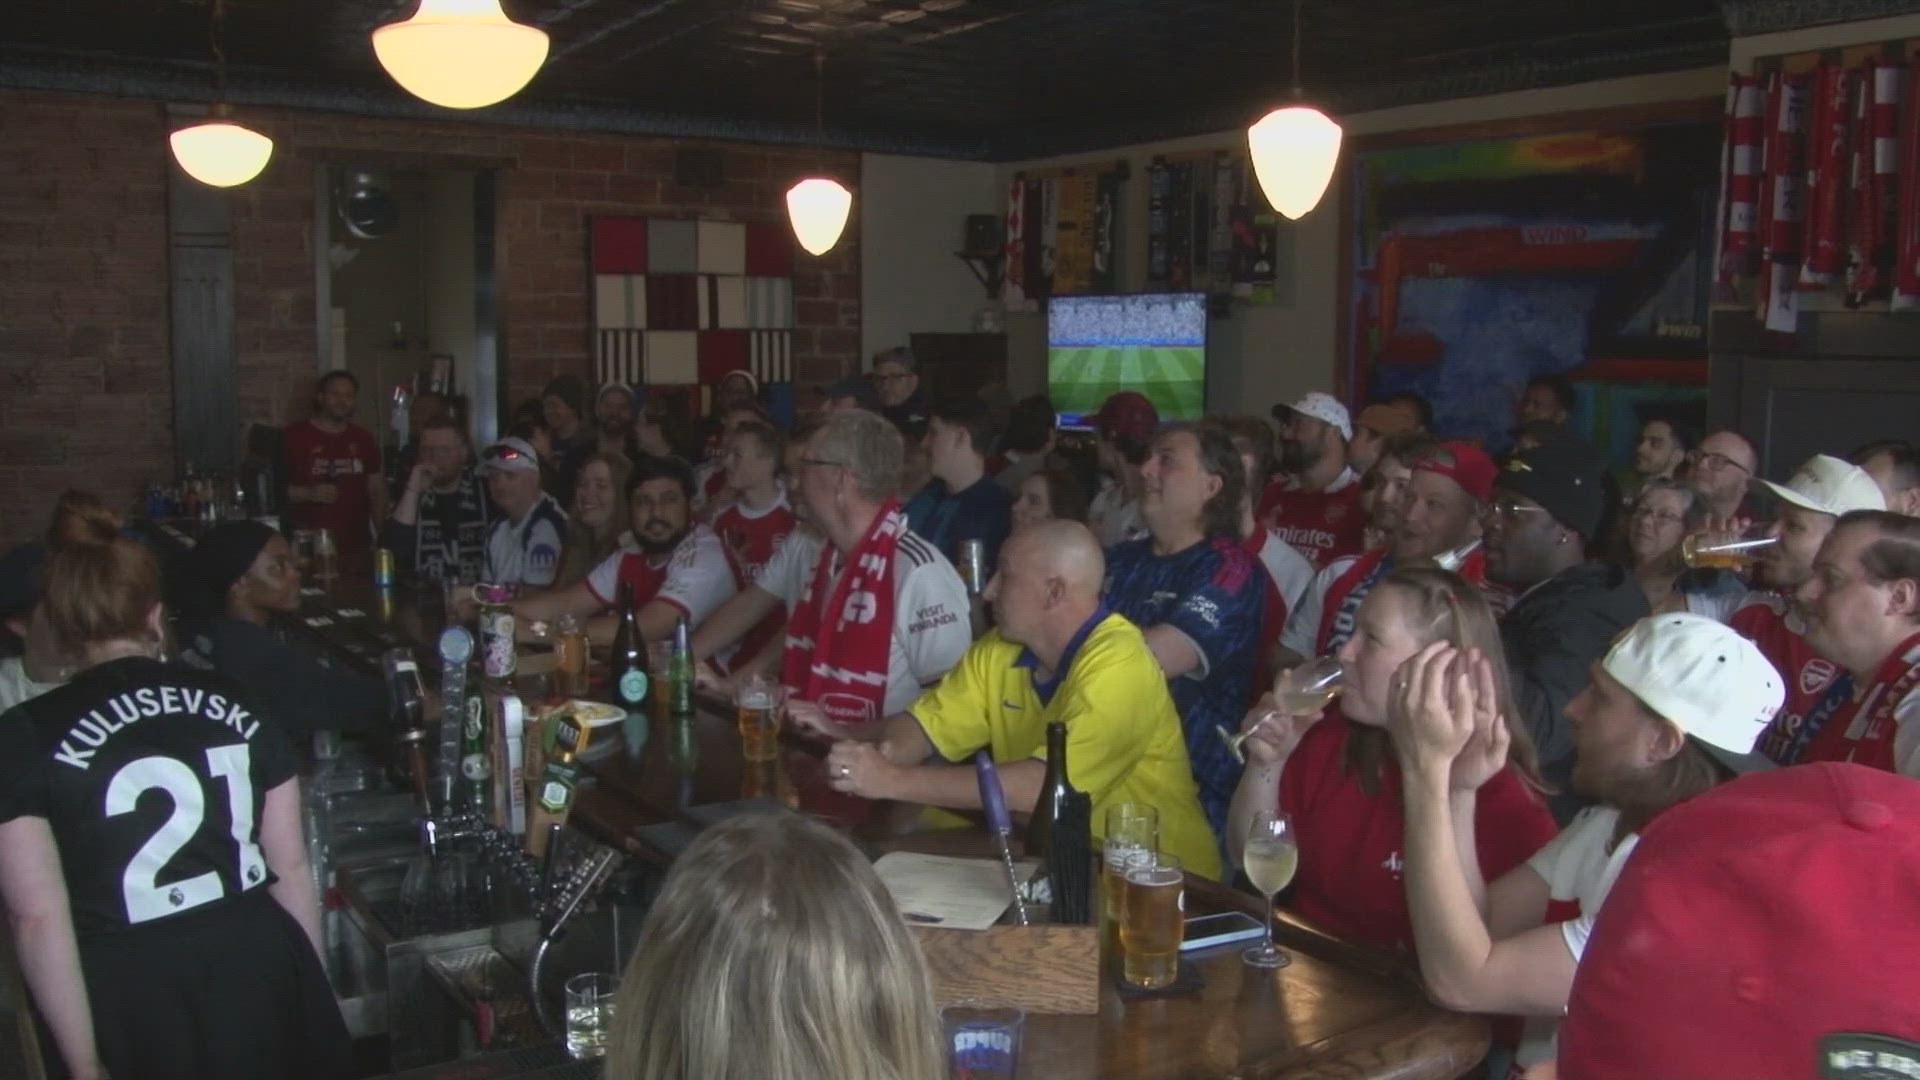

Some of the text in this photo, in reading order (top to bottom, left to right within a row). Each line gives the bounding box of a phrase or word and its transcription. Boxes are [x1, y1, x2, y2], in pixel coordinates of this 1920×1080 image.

[1272, 525, 1337, 549] mirates
[916, 603, 945, 619] VISIT
[908, 613, 959, 635] RWANDA
[53, 685, 260, 770] KULUSEVSKI
[105, 743, 267, 924] 21
